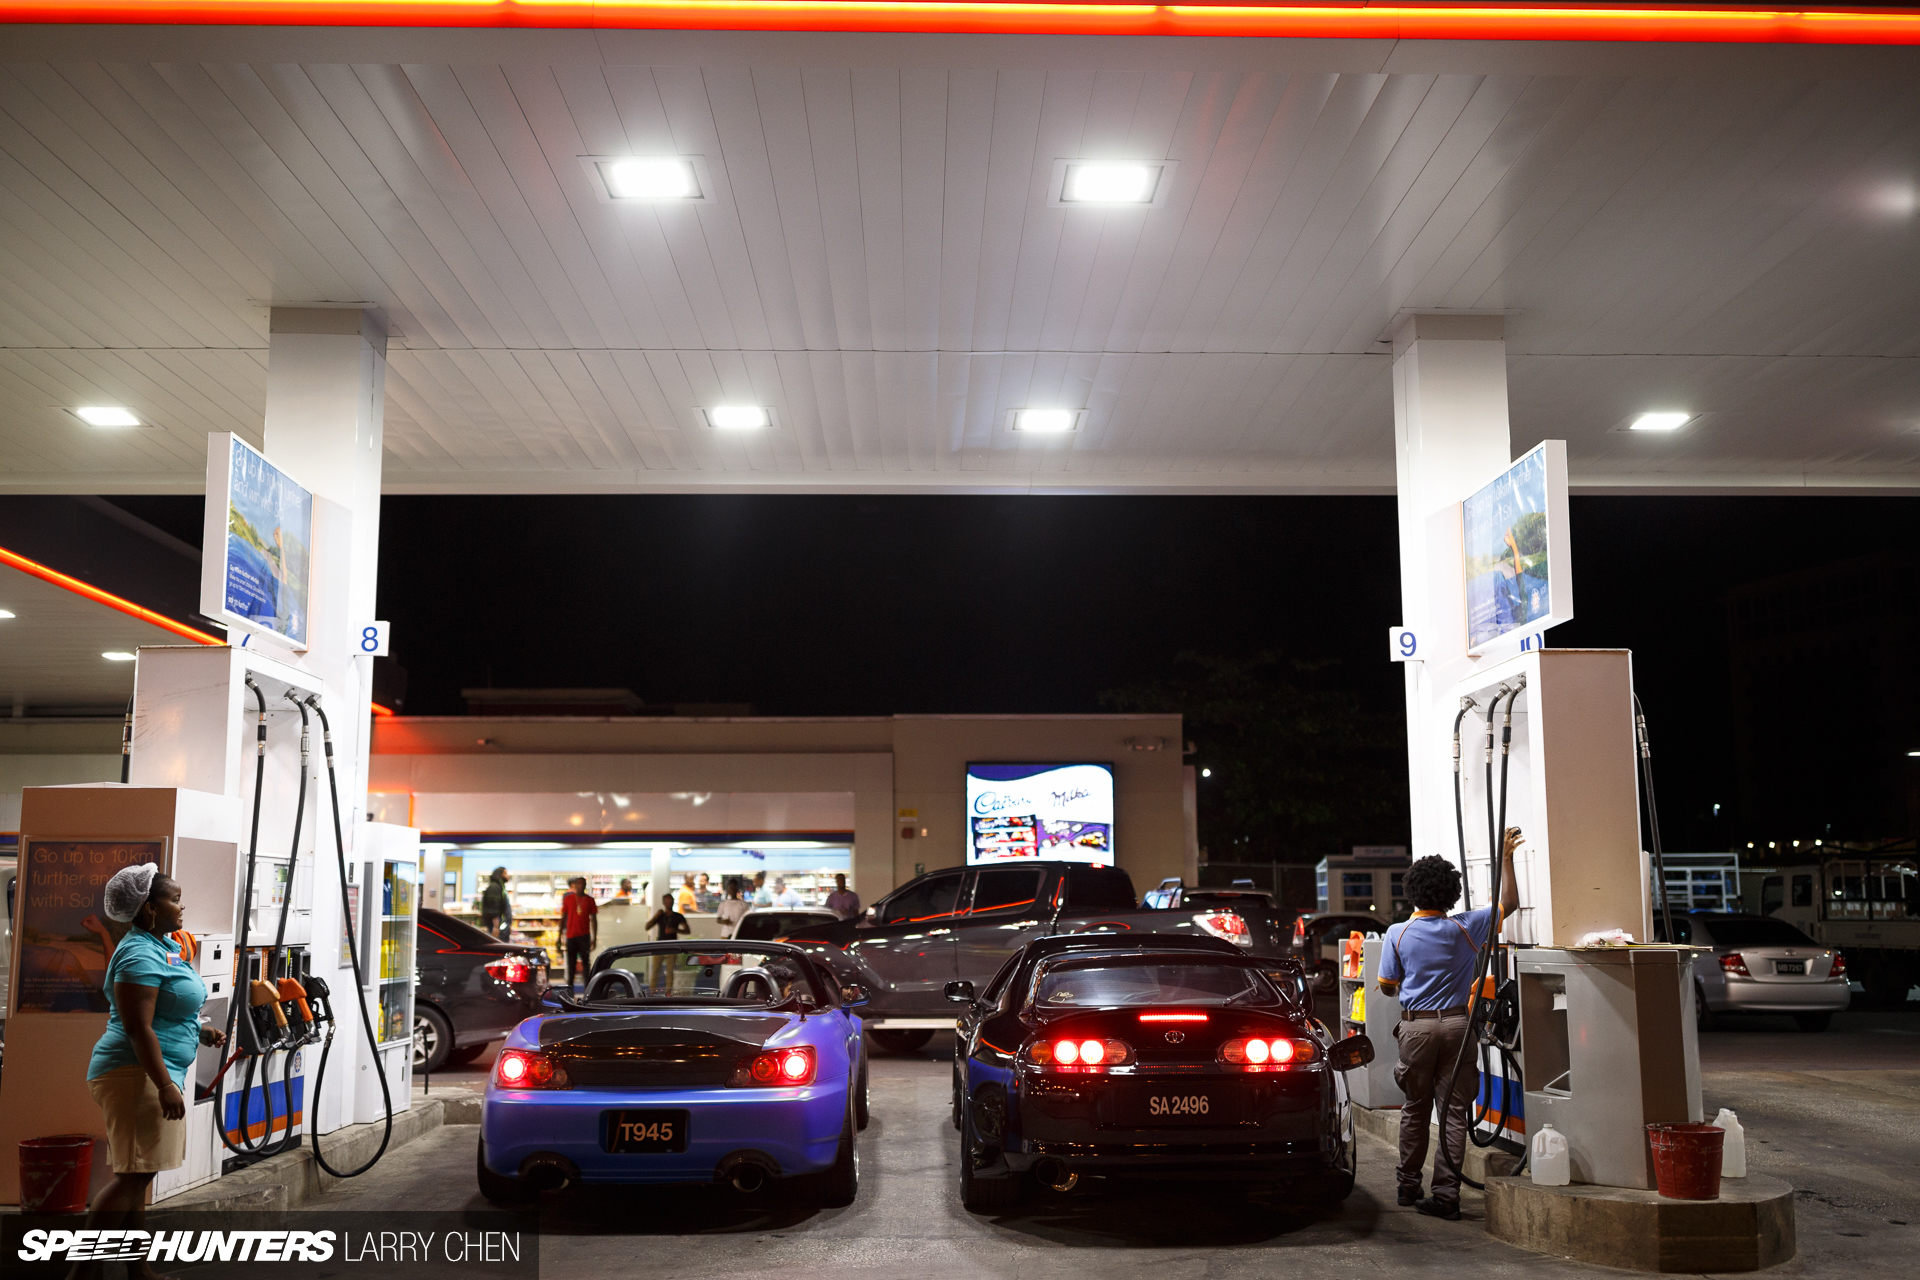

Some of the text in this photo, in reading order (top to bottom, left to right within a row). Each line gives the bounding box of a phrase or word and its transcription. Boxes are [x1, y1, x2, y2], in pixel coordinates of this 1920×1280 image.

[361, 627, 379, 652] 8
[1400, 631, 1417, 657] 9
[34, 848, 58, 864] Go
[63, 850, 84, 867] up
[89, 849, 104, 864] to
[32, 871, 109, 886] further an
[31, 892, 95, 908] with Sol
[621, 1122, 673, 1142] T945
